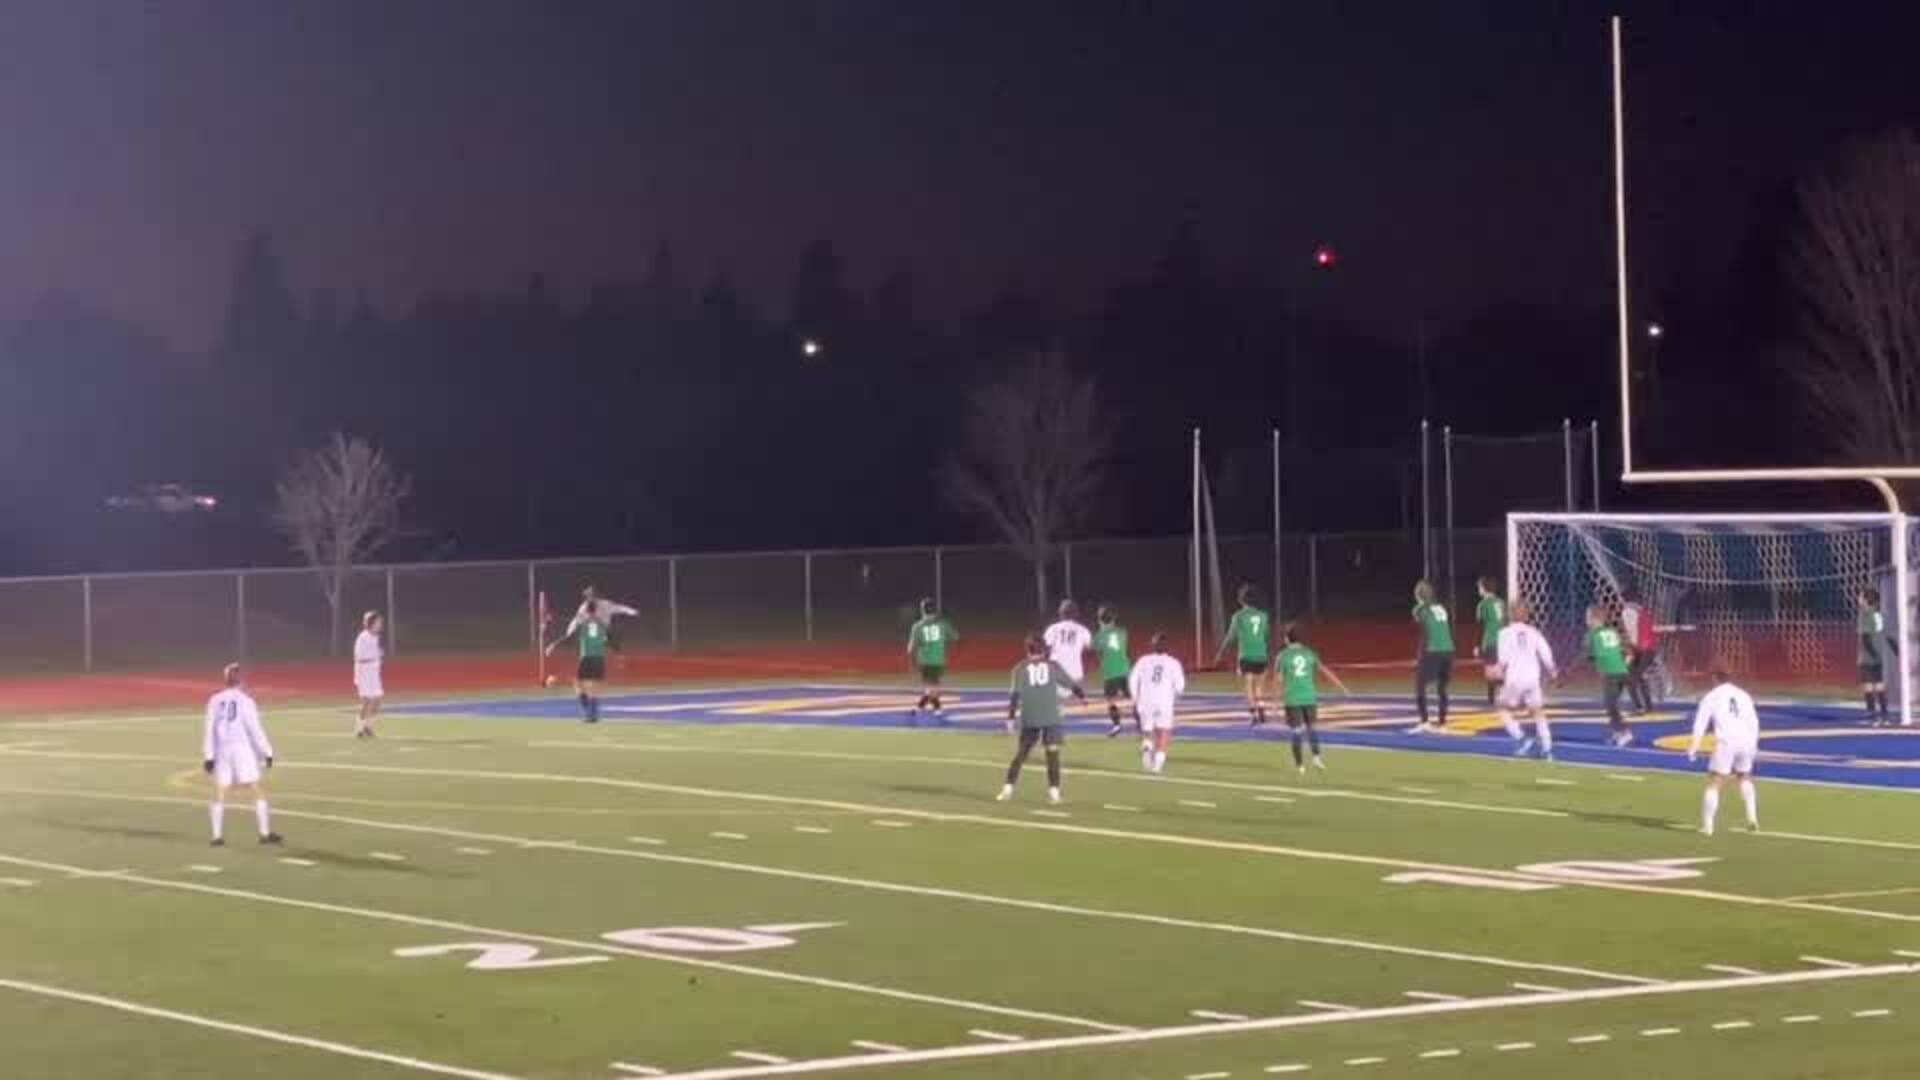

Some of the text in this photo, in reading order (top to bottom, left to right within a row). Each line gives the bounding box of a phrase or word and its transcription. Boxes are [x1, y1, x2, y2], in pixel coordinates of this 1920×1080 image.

[923, 624, 940, 641] 19
[1250, 615, 1261, 635] 7
[1027, 662, 1049, 686] 10
[1151, 664, 1163, 684] 8
[1293, 655, 1307, 676] 2
[393, 926, 798, 969] 20
